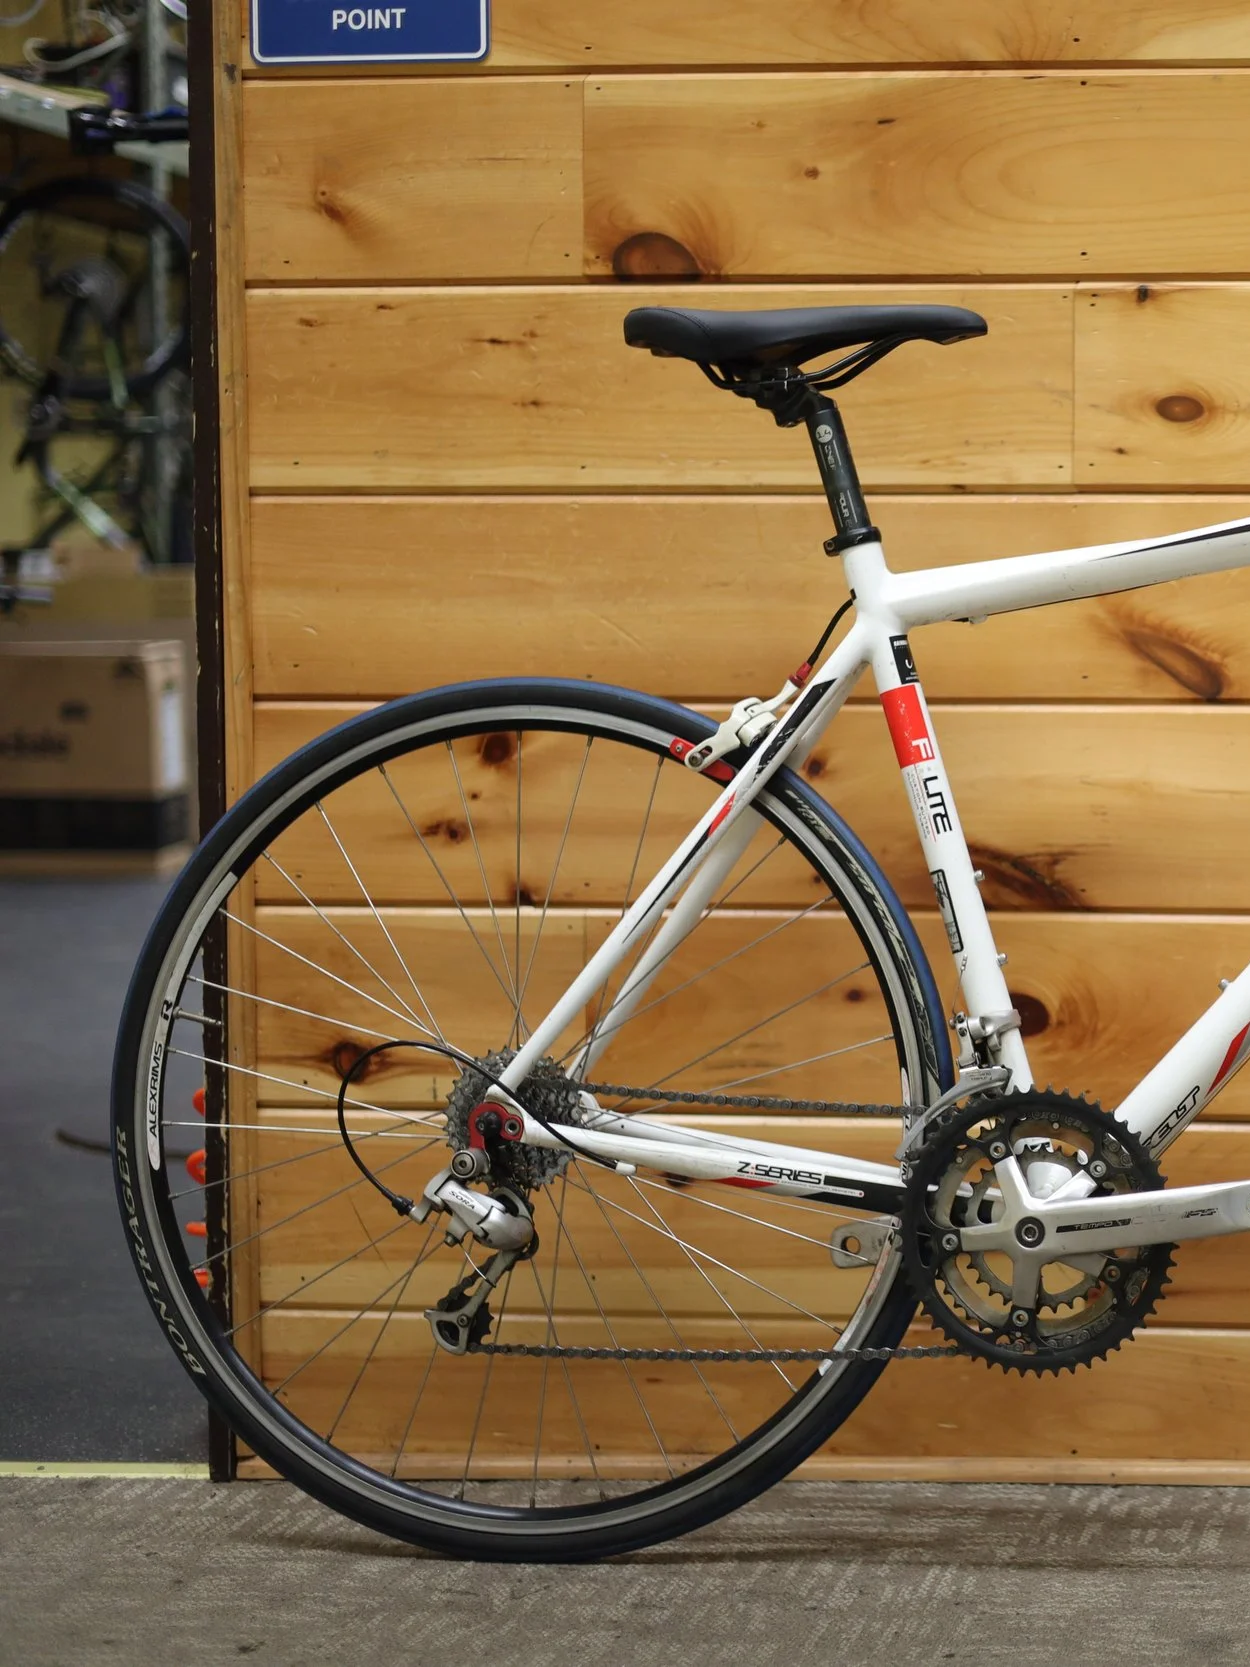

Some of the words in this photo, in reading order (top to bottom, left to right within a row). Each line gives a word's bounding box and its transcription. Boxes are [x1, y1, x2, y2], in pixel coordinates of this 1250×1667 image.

[332, 8, 407, 31] POINT
[922, 775, 953, 835] LITE
[148, 1041, 163, 1139] ALEXRIMS
[448, 1190, 476, 1211] SORA
[1074, 1220, 1115, 1230] TEMPO
[116, 1125, 207, 1377] BONTRAGER
